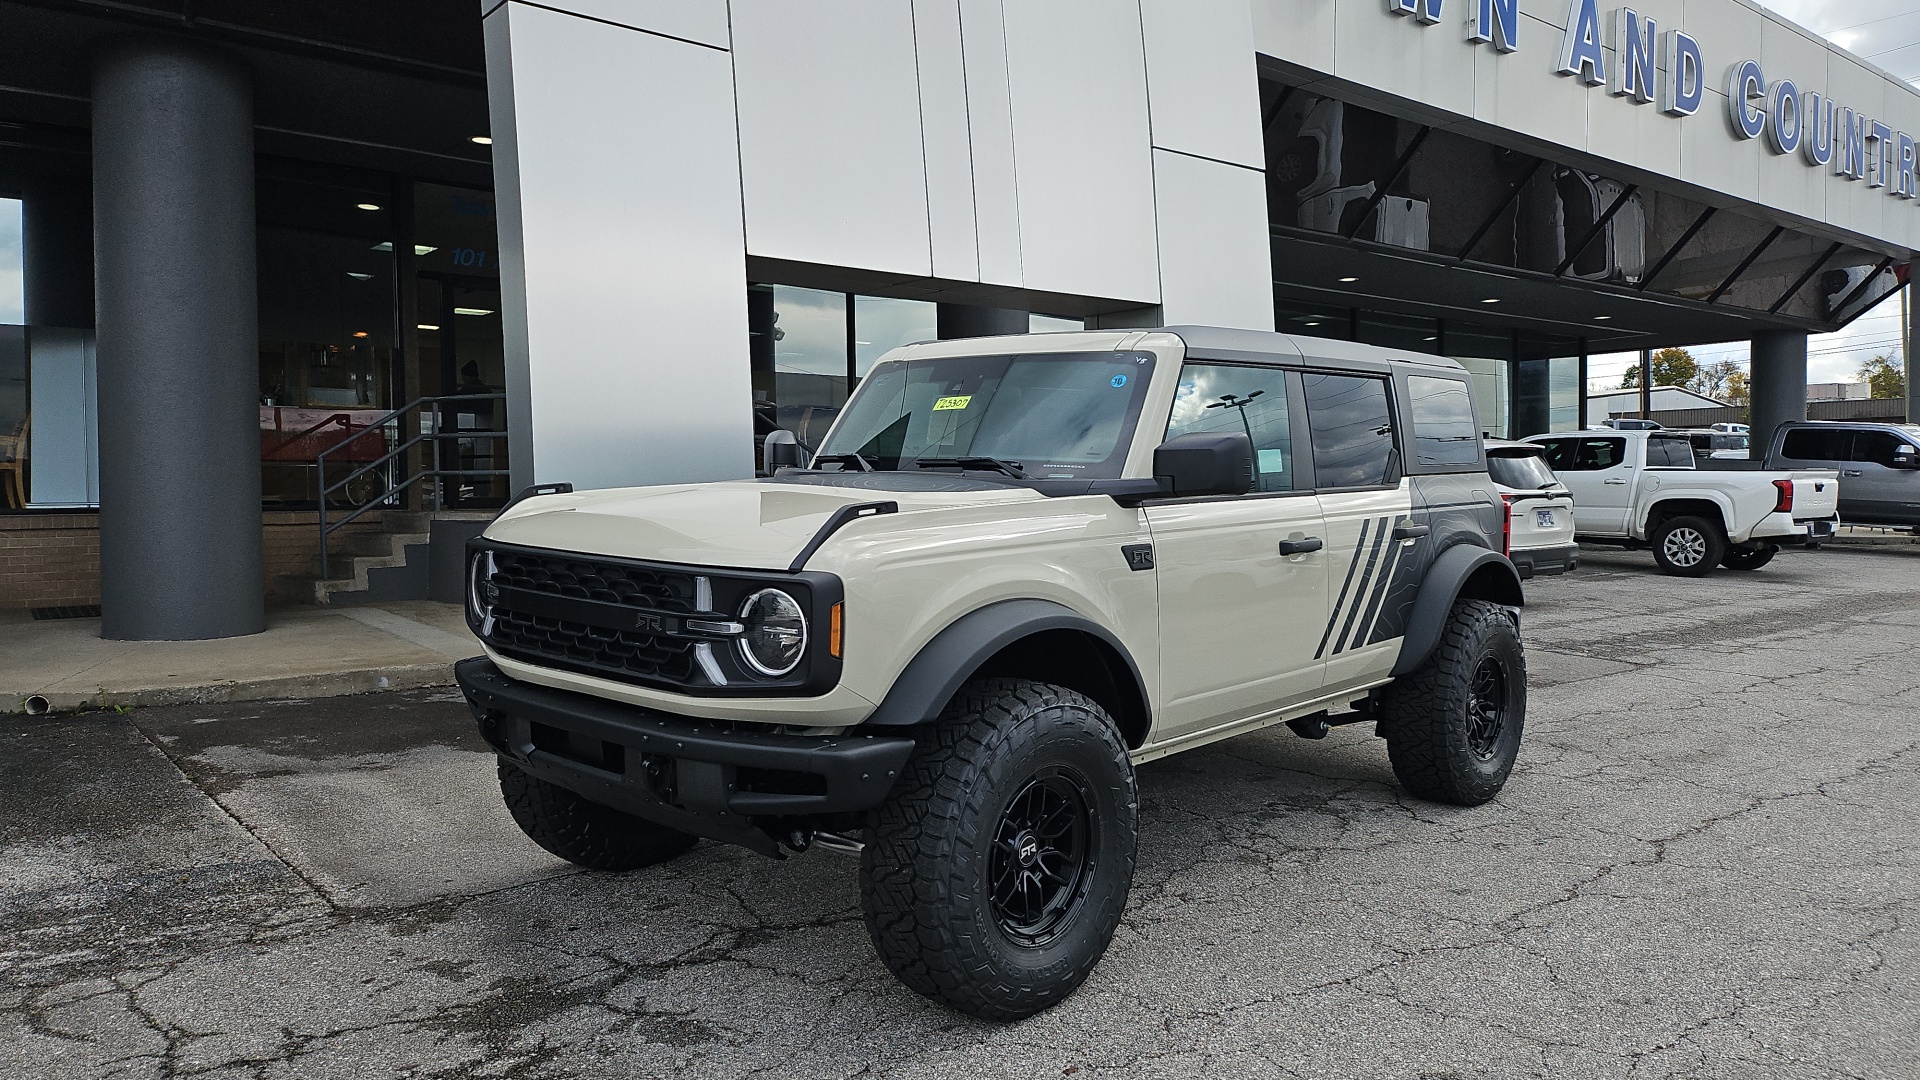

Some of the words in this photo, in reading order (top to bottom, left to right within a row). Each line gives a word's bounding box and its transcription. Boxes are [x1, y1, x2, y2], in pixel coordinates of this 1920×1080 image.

[1558, 0, 1705, 117] AND
[1728, 60, 1920, 200] COUNTR
[452, 247, 486, 268] 101
